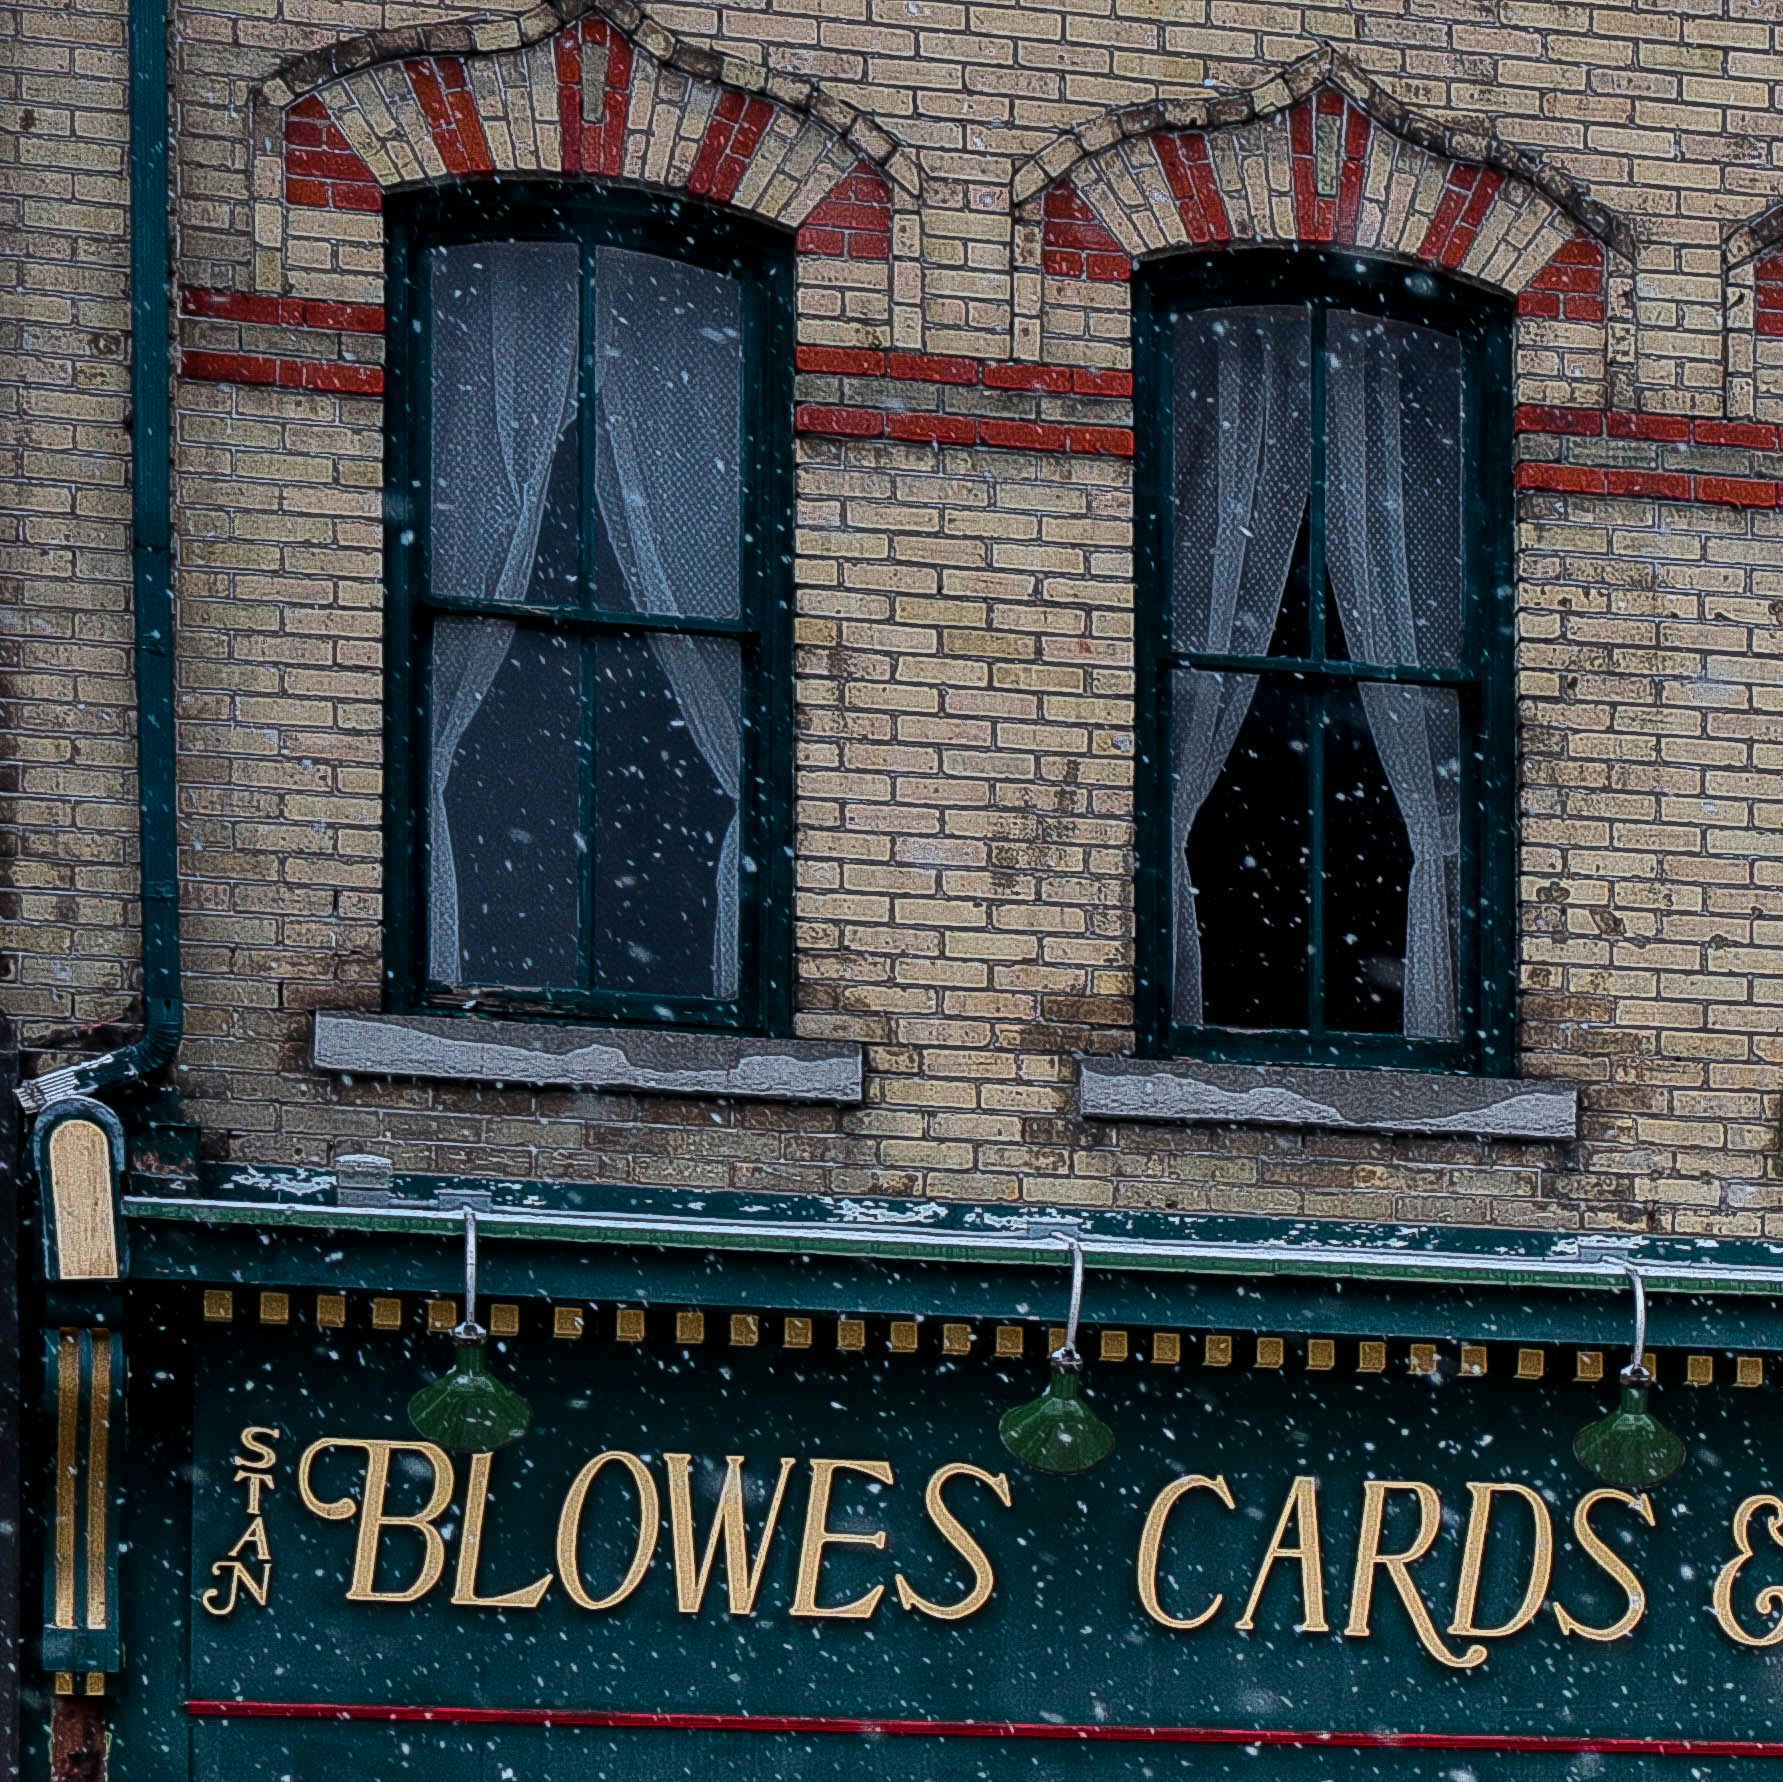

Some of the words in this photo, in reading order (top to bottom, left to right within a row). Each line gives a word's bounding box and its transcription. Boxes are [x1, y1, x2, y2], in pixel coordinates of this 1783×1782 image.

[202, 1426, 280, 1616] STAN
[297, 1435, 1011, 1620] BLOWES
[1136, 1474, 1656, 1668] CARDS
